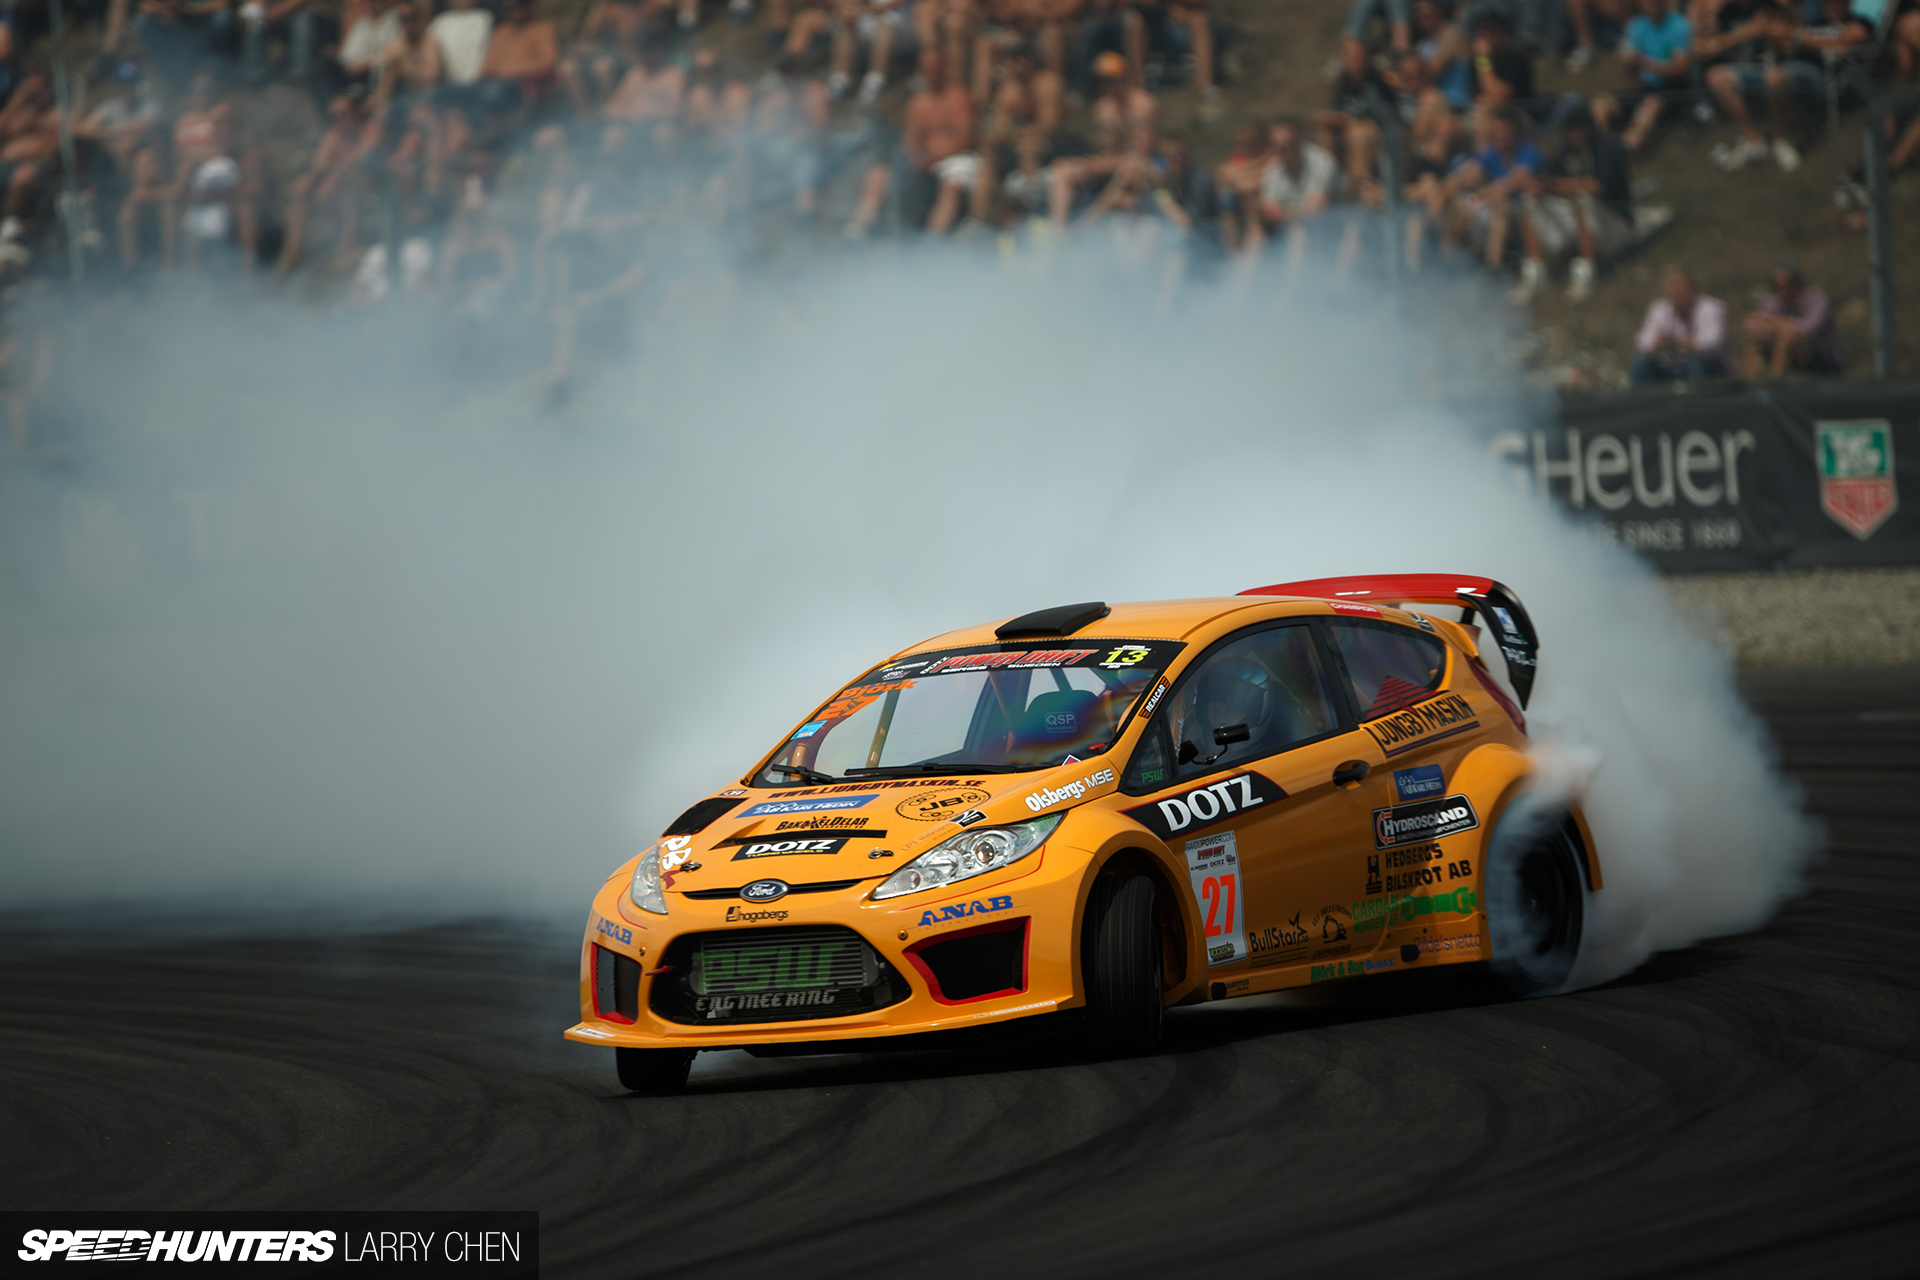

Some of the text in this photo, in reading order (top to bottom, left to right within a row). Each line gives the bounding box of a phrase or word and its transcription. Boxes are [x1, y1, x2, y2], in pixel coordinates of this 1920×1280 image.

[930, 651, 1027, 674] POWER
[1017, 648, 1100, 666] DRIFT
[1104, 649, 1150, 664] 13
[835, 679, 919, 701] Björk
[1145, 684, 1167, 713] REALCAR
[812, 693, 882, 723] 27
[1046, 713, 1076, 726] QSP
[1140, 768, 1164, 785] PSW
[767, 779, 987, 800] WWW.LJUNGBYMASKIN.SE
[1024, 768, 1116, 812] Olsbergs MSE
[919, 797, 965, 812] JB
[1157, 774, 1264, 832] DOTZ
[1383, 806, 1469, 836] HYDROSCAND
[745, 838, 838, 856] DOTZ
[1385, 842, 1444, 870] HEDBERGS
[1386, 859, 1473, 893] BILSKROT AB
[748, 883, 776, 897] Ford
[917, 895, 1014, 927] ANAB
[1201, 873, 1237, 938] 27
[692, 943, 846, 996] PSW
[1310, 963, 1336, 982] Björk
[1337, 960, 1346, 976] &
[1347, 959, 1366, 975] Son
[1365, 958, 1395, 972] BUMAX
[694, 987, 841, 1012] ENGINEERING
